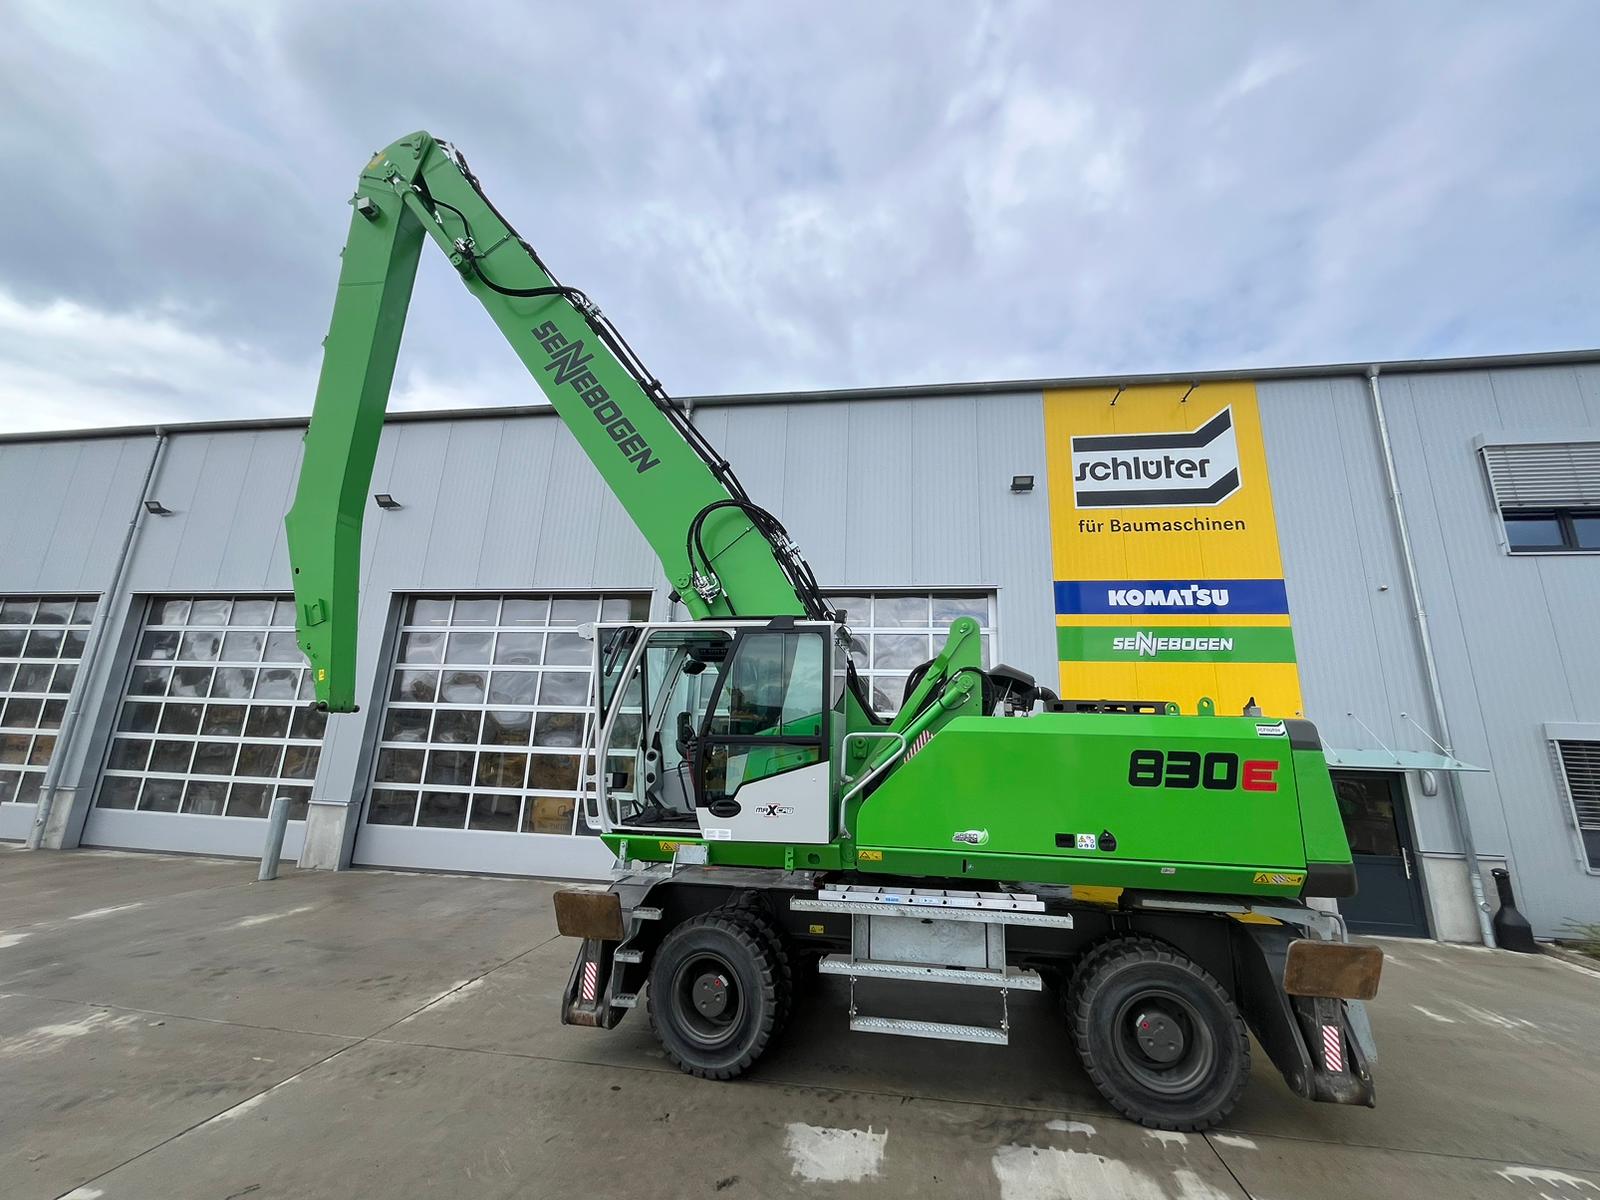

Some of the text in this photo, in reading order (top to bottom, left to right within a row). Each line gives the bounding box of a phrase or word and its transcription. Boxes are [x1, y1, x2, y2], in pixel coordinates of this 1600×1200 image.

[531, 320, 661, 474] SENNEBOGEN
[1075, 455, 1210, 482] schlüter
[1078, 517, 1246, 533] für Baumaschinen
[1108, 584, 1229, 606] KOMATSU
[1113, 632, 1233, 657] SENNEBOGEN
[1128, 750, 1280, 793] 830E
